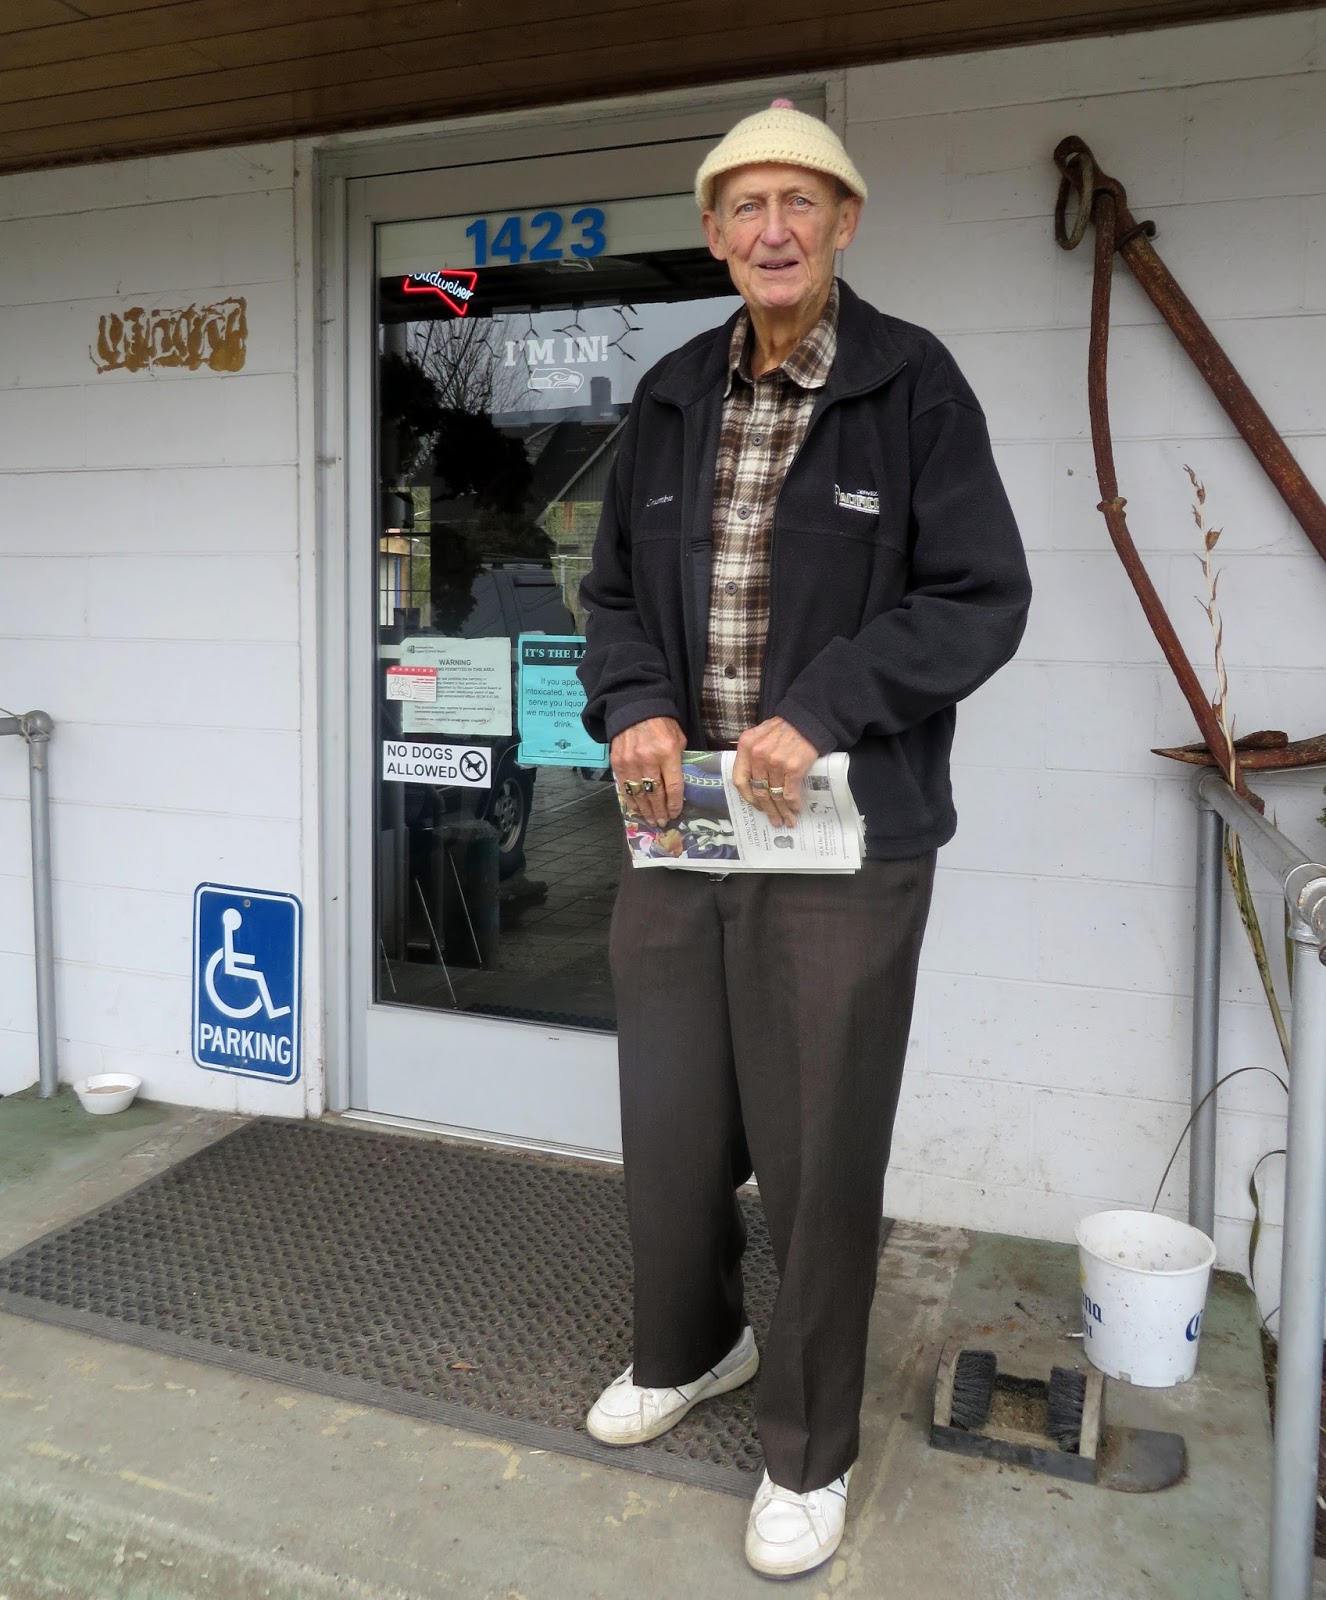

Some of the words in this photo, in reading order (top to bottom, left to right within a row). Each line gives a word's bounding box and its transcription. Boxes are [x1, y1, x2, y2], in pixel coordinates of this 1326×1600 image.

[465, 207, 607, 266] 1423
[504, 339, 556, 367] I'M
[563, 335, 608, 364] IN!
[524, 648, 545, 658] IT'S
[548, 649, 571, 658] THE
[541, 677, 546, 685] If
[525, 688, 565, 697] intoxicated,
[564, 699, 584, 708] liquor
[387, 744, 408, 758] NO
[412, 746, 453, 761] DOGS
[386, 762, 458, 779] ALLOWED
[200, 1022, 291, 1065] PARKING
